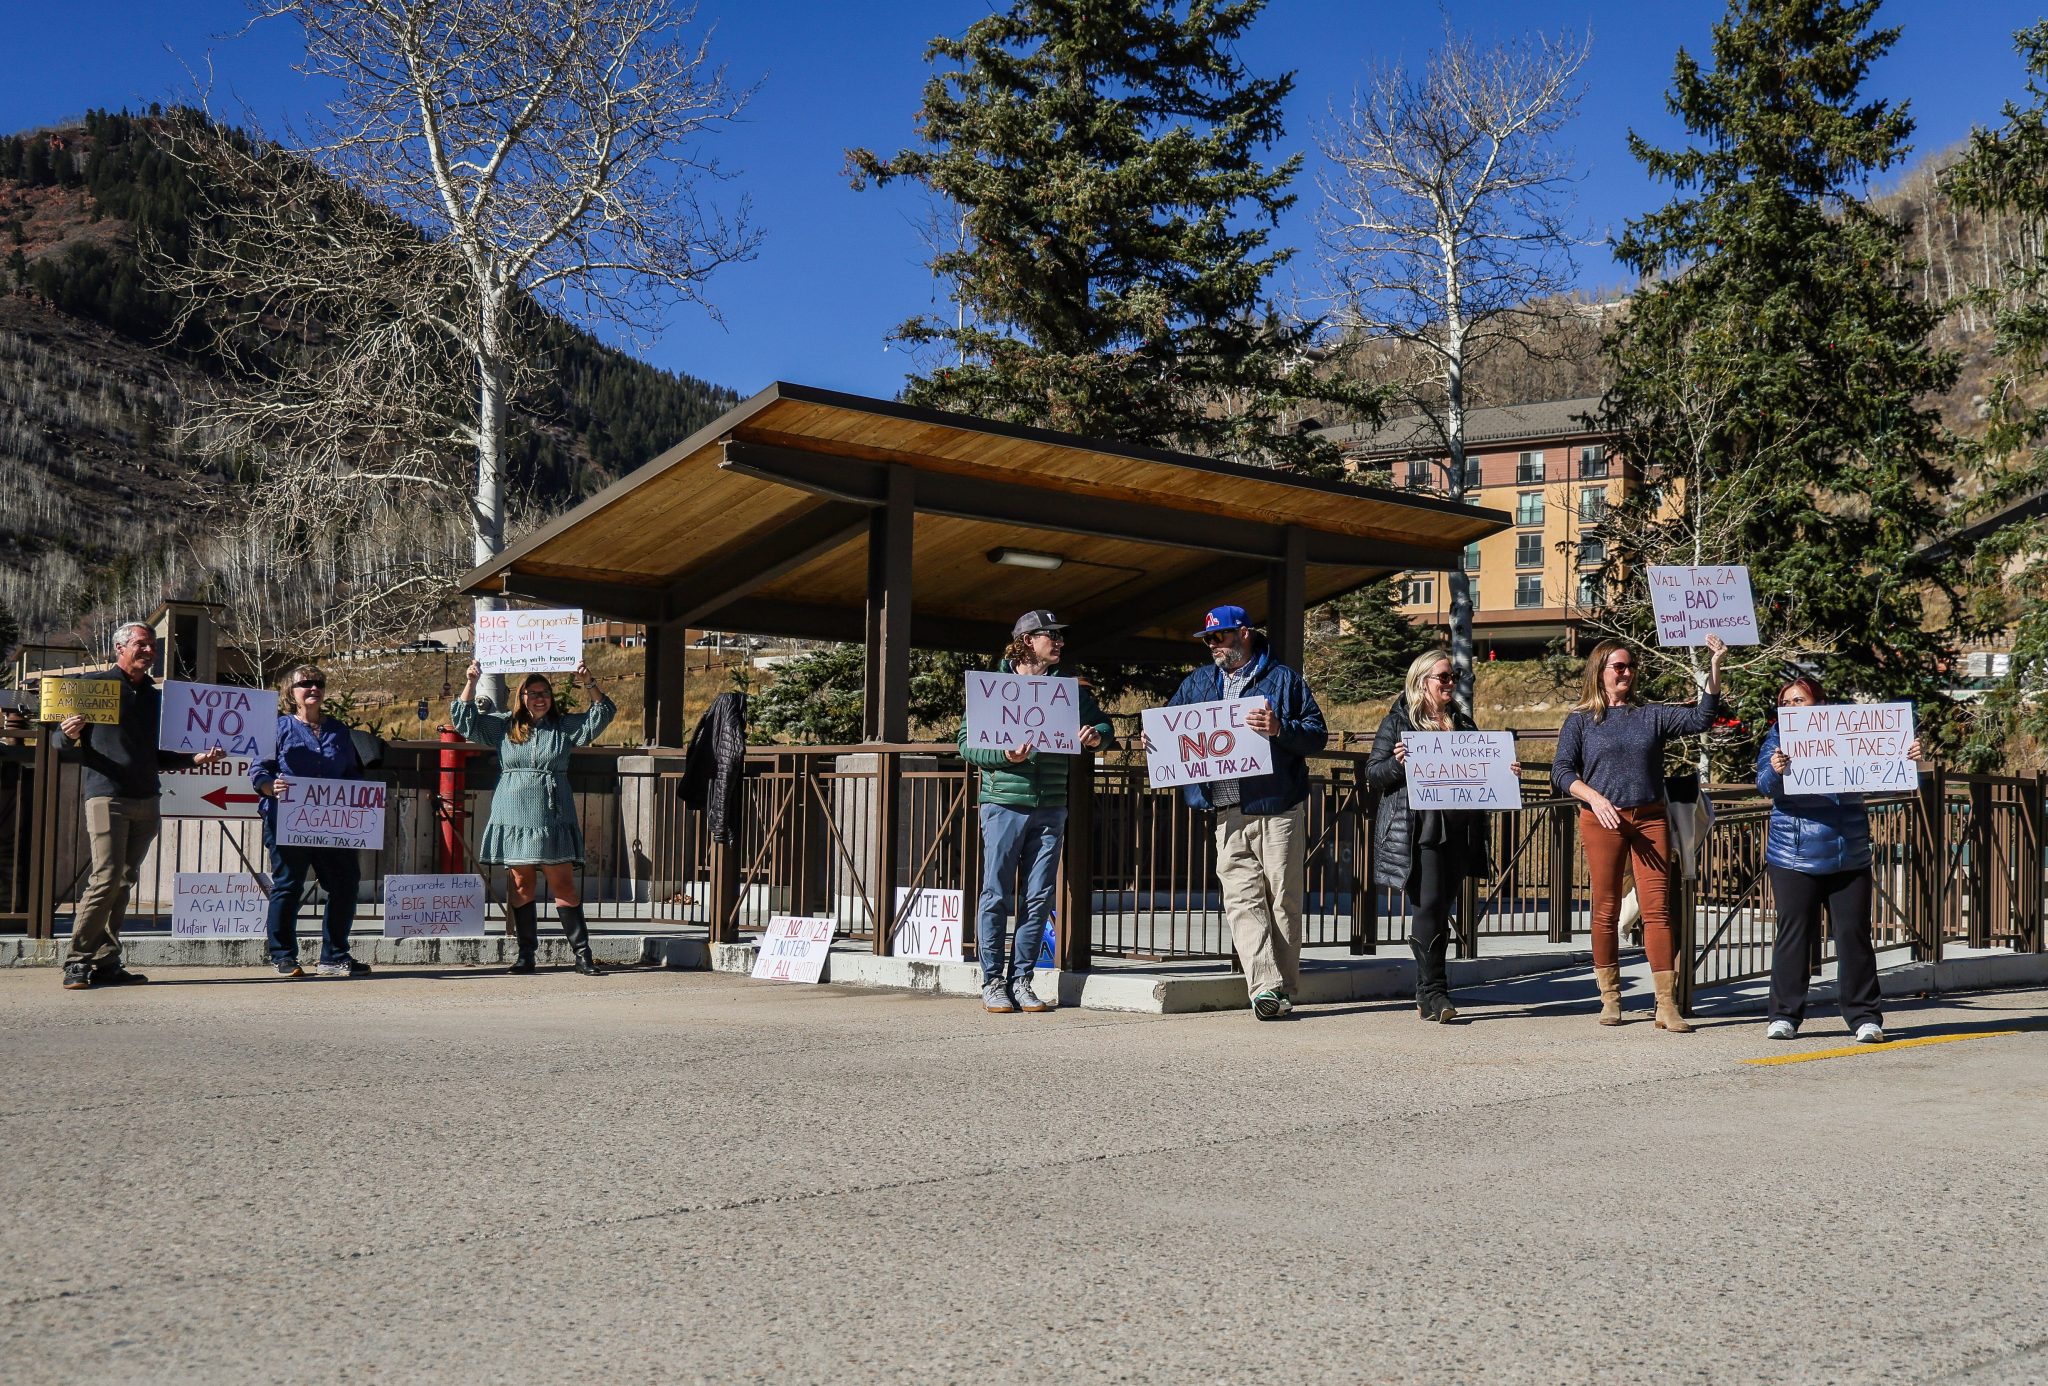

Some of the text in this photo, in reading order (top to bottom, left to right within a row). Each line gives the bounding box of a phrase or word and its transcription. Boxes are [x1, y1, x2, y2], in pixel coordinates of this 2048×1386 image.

[1716, 568, 1736, 585] 2A
[1685, 590, 1719, 609] BAD
[479, 612, 580, 630] BIG Corporate
[1660, 611, 1686, 624] small
[1689, 614, 1751, 630] businesses
[478, 630, 513, 643] Hotels
[519, 631, 535, 641] will
[1664, 625, 1687, 640] local
[488, 641, 558, 656] EXEMPT
[499, 656, 527, 667] helping
[530, 655, 546, 663] with
[550, 655, 576, 666] housing
[44, 682, 53, 694] I
[59, 682, 78, 694] AM
[980, 679, 1071, 706] VOTA
[43, 697, 119, 709] I AM AGAINST
[190, 688, 251, 711] VOTA
[80, 713, 97, 722] AX
[100, 714, 115, 722] 2A
[187, 707, 244, 736] NO
[1002, 705, 1045, 727] NO
[1162, 704, 1244, 732] VOTE
[1781, 709, 1905, 732] I AM AGAINST
[180, 735, 259, 755] A LA 2A
[980, 730, 989, 743] A
[995, 731, 1013, 744] LA
[1025, 729, 1051, 748] 2A
[1055, 739, 1074, 750] Vail
[1178, 729, 1236, 762] NO
[1433, 737, 1443, 754] A
[1450, 734, 1497, 745] LOCAL
[1786, 731, 1907, 758] UNFAIR TAXES!
[1450, 748, 1501, 758] WORKER
[1155, 757, 1261, 782] ON VAIL TAX 2A
[1413, 763, 1490, 778] AGAINST
[1792, 766, 1834, 786] VOTE
[1844, 765, 1865, 786] NO
[1882, 761, 1907, 784] 2A
[280, 783, 388, 809] I AM A LOCAL
[1416, 787, 1497, 802] VAIL TAX 2A
[295, 809, 369, 828] AGAINST
[287, 834, 366, 848] LODGING TAX 2A
[388, 877, 481, 893] Corporate Hotels
[190, 899, 269, 912] AGAINST
[401, 895, 475, 910] BIG BREAK
[942, 895, 959, 918] NO
[388, 910, 463, 923] under UNFAIR
[177, 918, 207, 935] Unfair
[213, 917, 230, 933] Vail
[233, 917, 249, 933] Tax
[401, 924, 450, 935] Tax 2A
[786, 920, 802, 936] NO
[814, 921, 829, 939] 2A
[769, 938, 810, 957] INSTEAD
[902, 920, 952, 957] ON 2A
[773, 960, 791, 976] ALL
